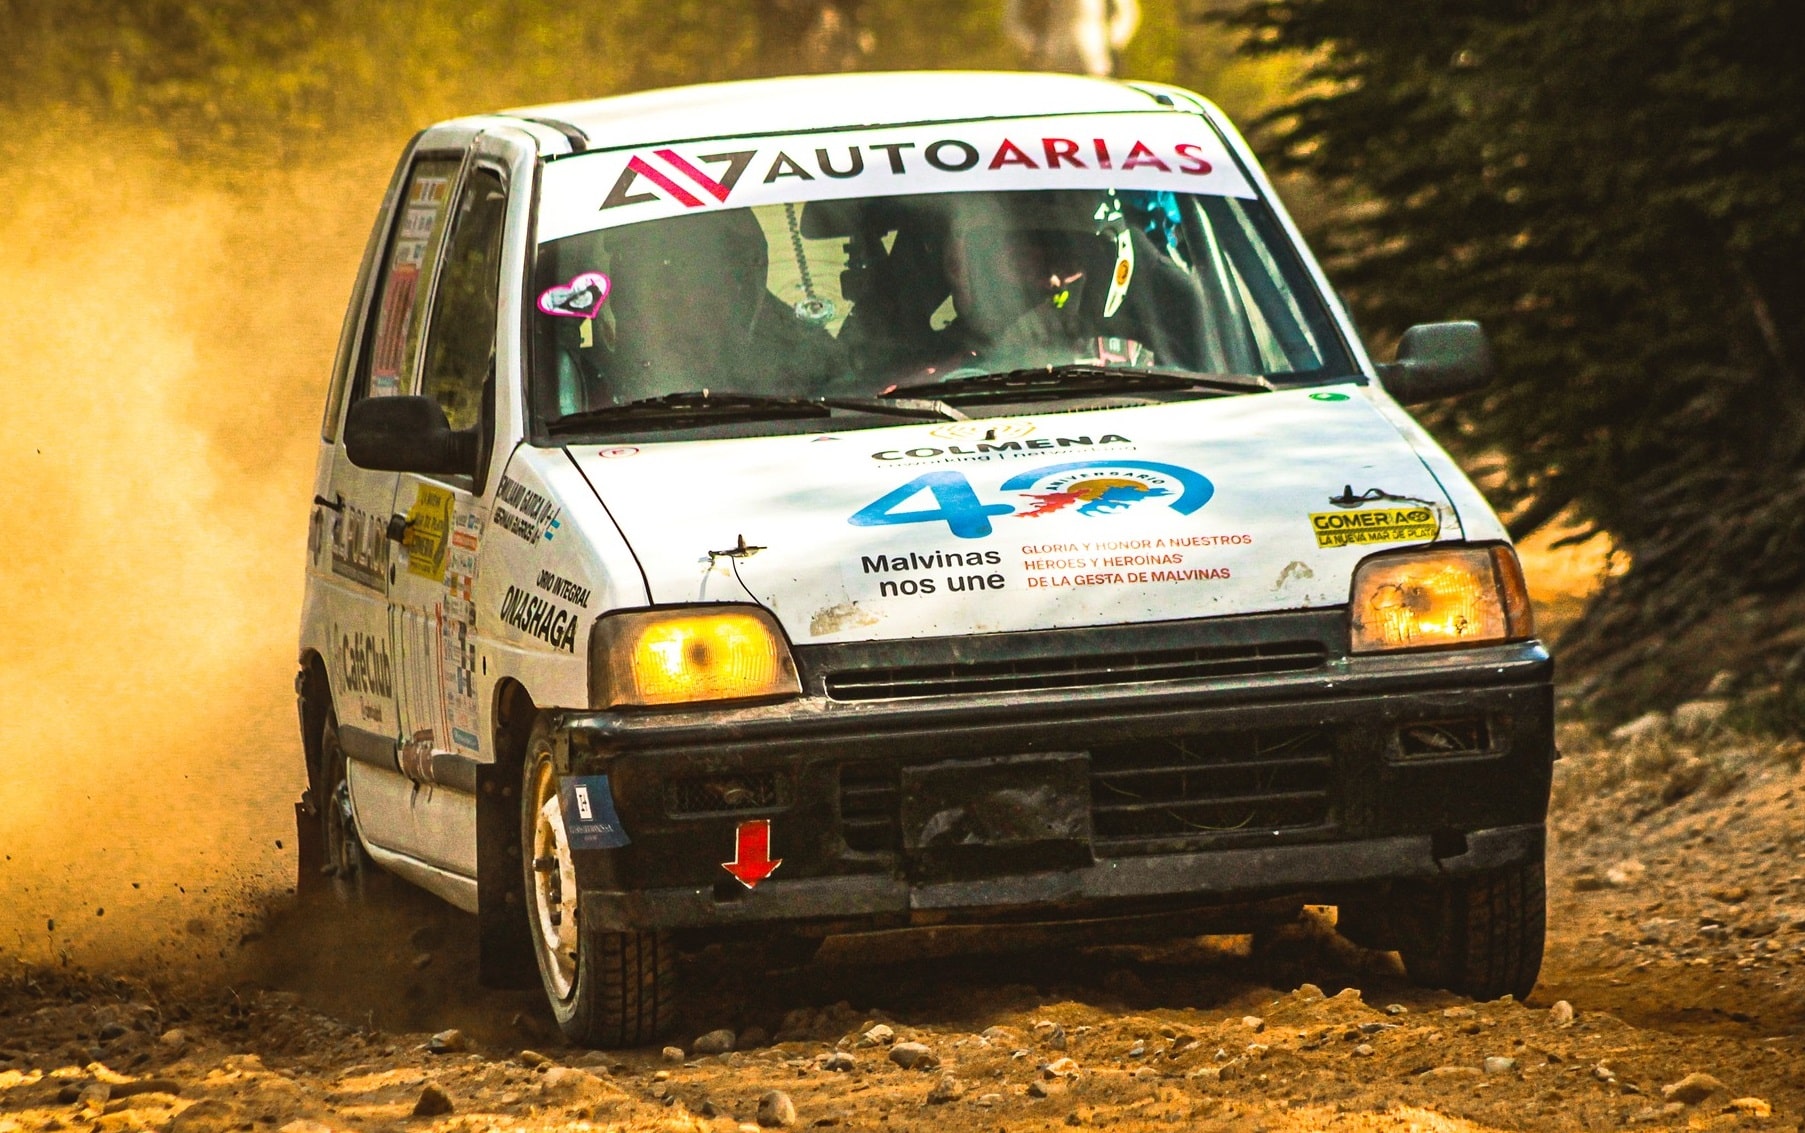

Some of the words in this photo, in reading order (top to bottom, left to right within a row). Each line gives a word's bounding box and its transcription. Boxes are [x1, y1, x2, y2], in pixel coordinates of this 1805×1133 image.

[763, 138, 1213, 184] AUTOARIAS
[871, 434, 1132, 461] COLMENA
[1045, 471, 1166, 491] ANIVERSARIO
[1022, 543, 1079, 555] GLORIA
[1082, 542, 1091, 551] Y
[1096, 540, 1151, 551] HONOR
[1156, 538, 1166, 548] A
[1169, 534, 1252, 547] NUESTROS
[1319, 535, 1332, 545] LA
[1335, 533, 1366, 544] NUEVA
[1369, 532, 1391, 542] MAR
[861, 548, 1002, 574] Malvinas
[1090, 557, 1100, 567] Y
[879, 577, 936, 598] nos
[948, 570, 1006, 593] une
[1028, 576, 1048, 588] DE
[1051, 575, 1071, 587] LA
[1074, 573, 1124, 586] GESTA
[1128, 571, 1149, 584] DE
[1151, 567, 1231, 582] MALVINAS
[552, 576, 592, 608] INTEGRAL
[500, 585, 578, 654] ONASHAGA
